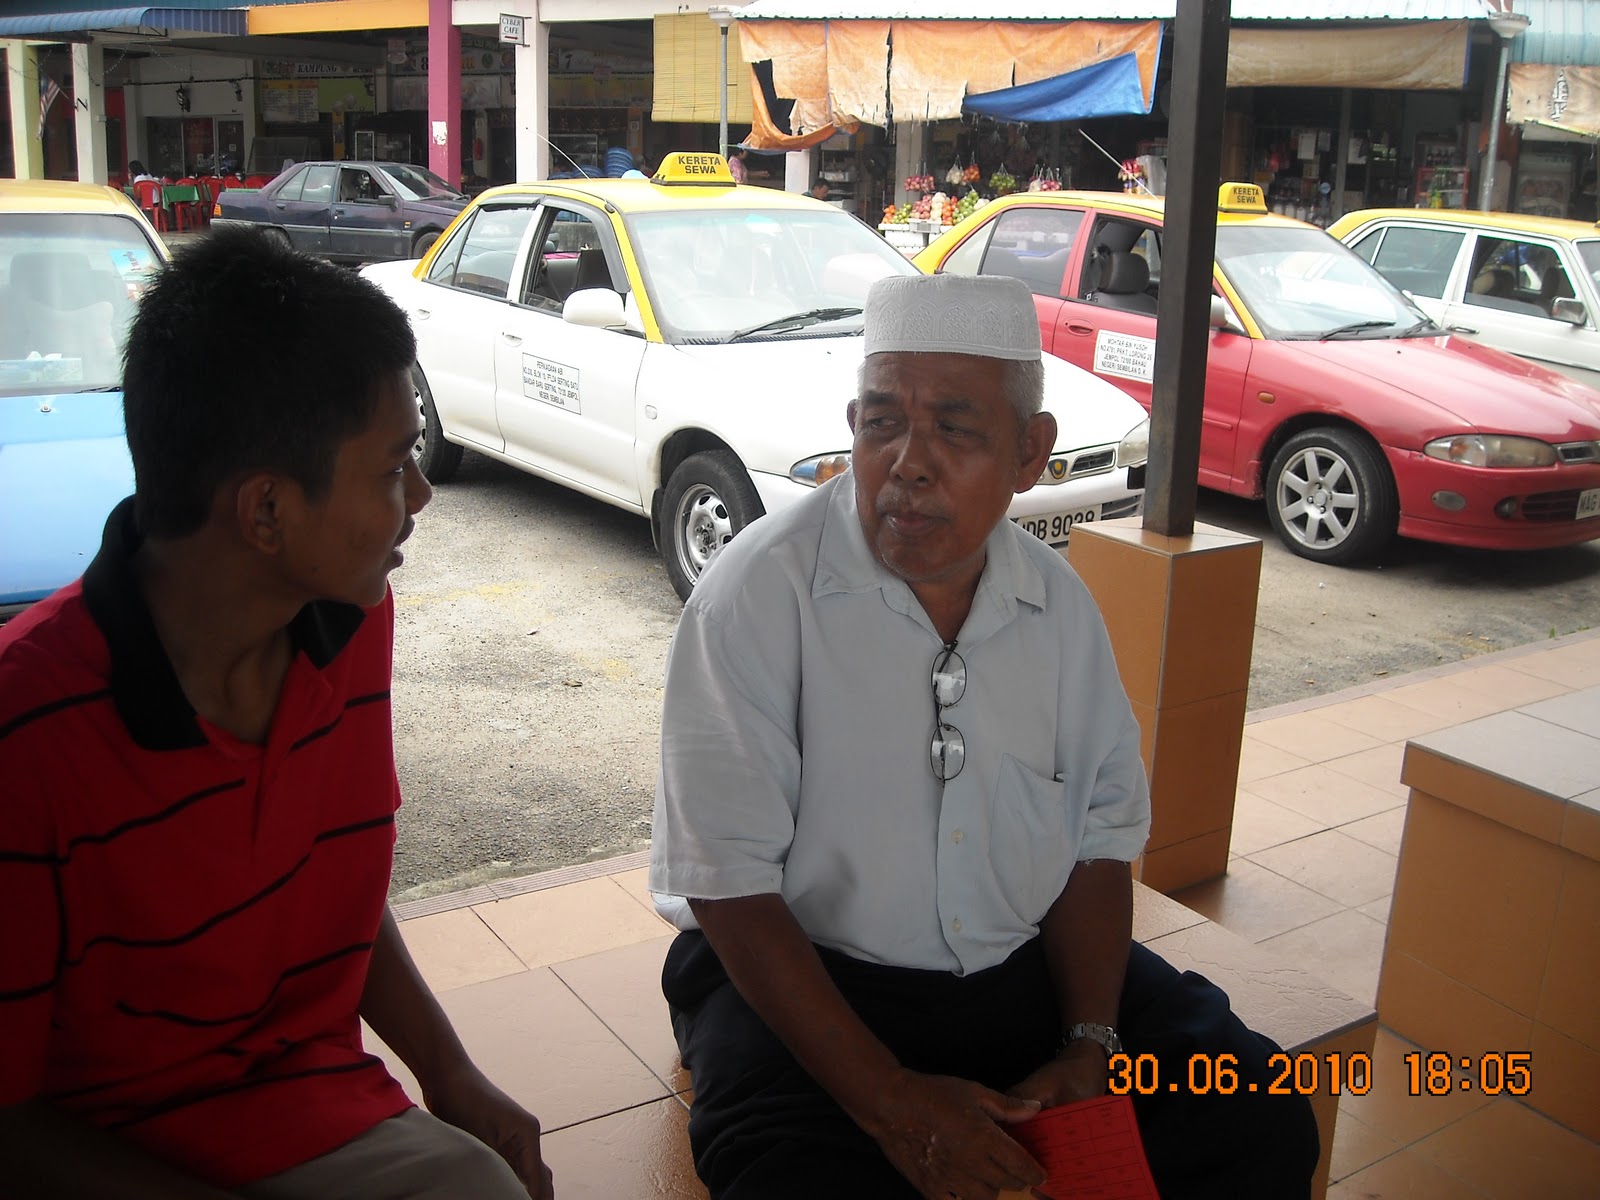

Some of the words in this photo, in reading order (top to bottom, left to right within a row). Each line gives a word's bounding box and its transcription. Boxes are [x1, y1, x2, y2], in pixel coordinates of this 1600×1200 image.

[502, 17, 521, 26] CYBER
[298, 64, 337, 73] KAMPUNG
[678, 156, 721, 166] KERETA
[684, 165, 716, 174] SEWA
[1233, 187, 1260, 196] KERETA
[1236, 195, 1257, 204] SEWA
